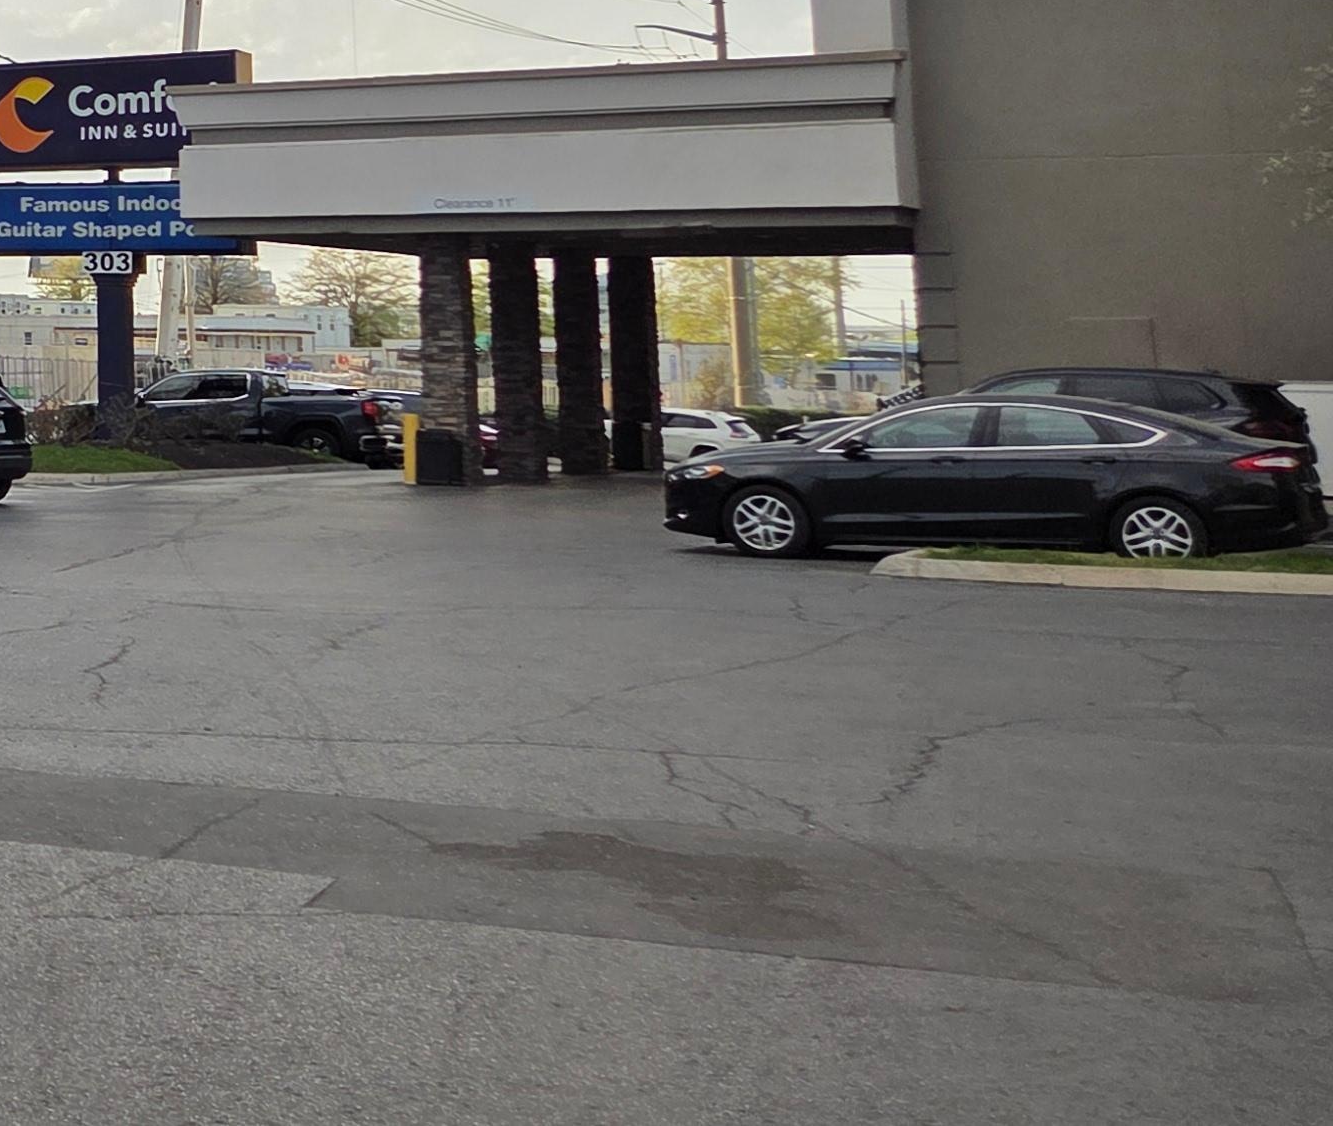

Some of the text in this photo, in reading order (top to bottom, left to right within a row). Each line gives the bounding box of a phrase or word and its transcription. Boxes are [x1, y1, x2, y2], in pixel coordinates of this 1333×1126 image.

[68, 78, 179, 117] Comf
[80, 125, 118, 140] INN
[123, 124, 137, 138] &
[19, 195, 182, 212] Famous Indoo
[72, 221, 162, 240] Shaped
[83, 252, 130, 272] 303
